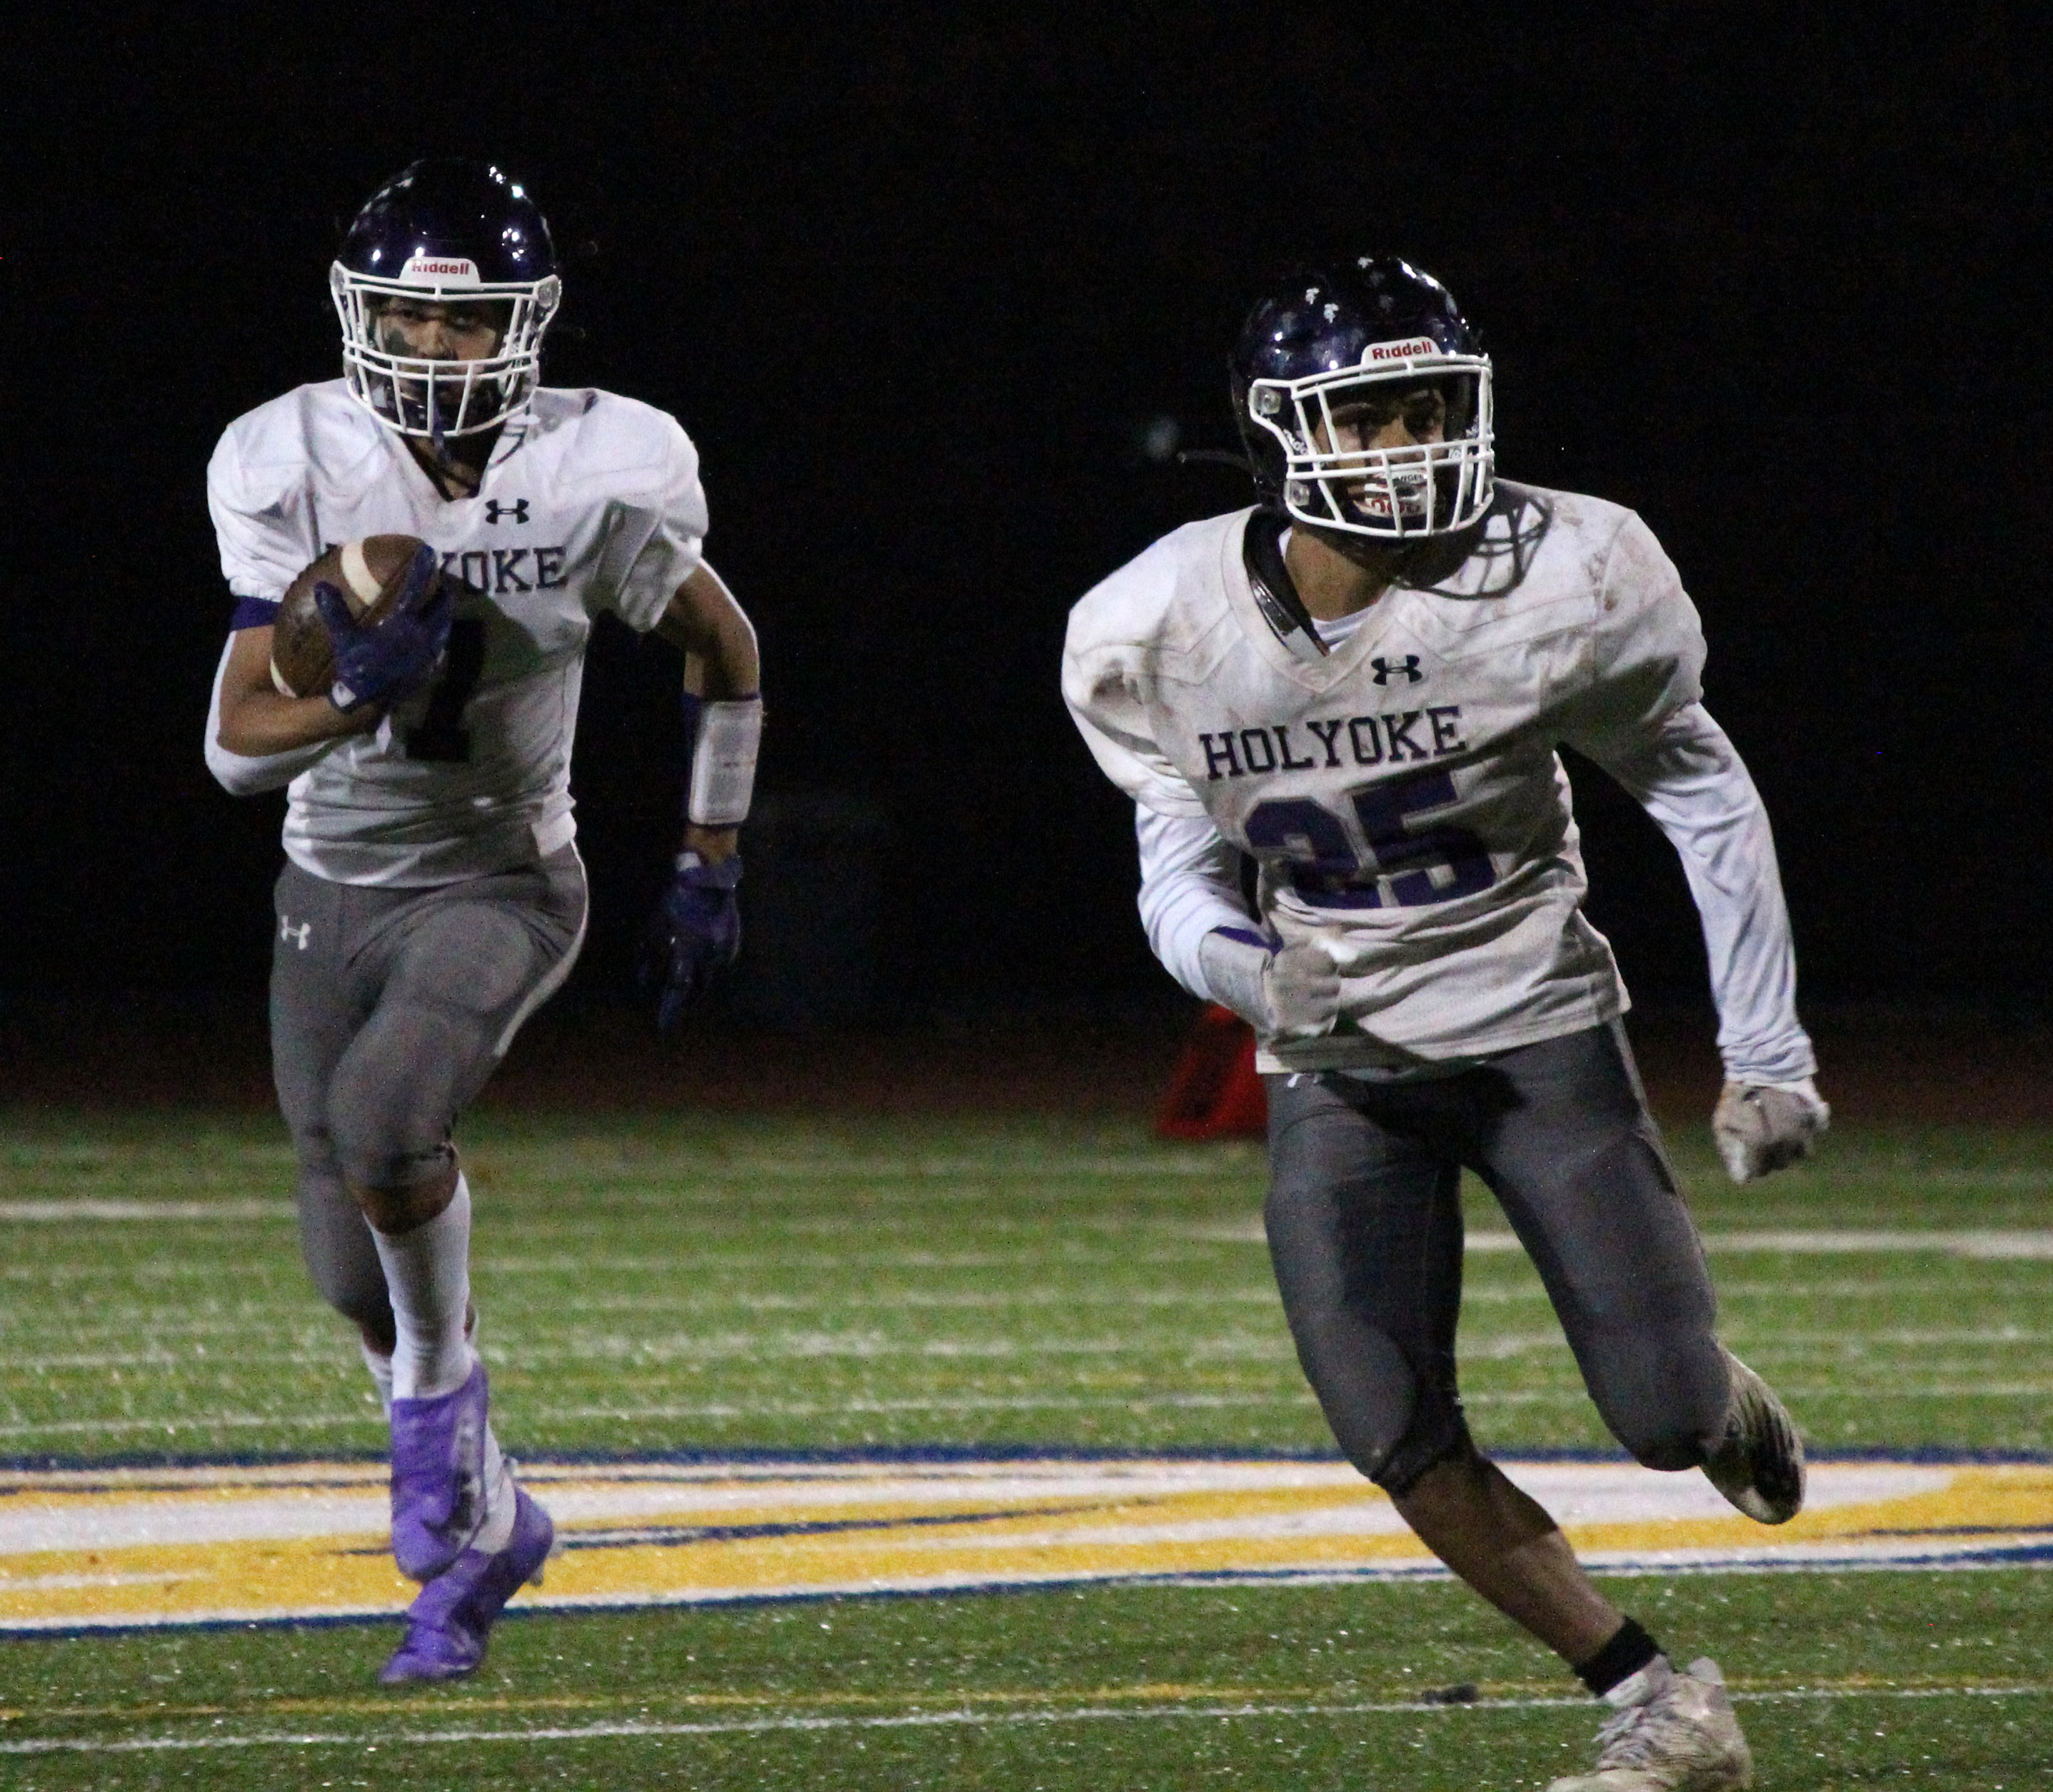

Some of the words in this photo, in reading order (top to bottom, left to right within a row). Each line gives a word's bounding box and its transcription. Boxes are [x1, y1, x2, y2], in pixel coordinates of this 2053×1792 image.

[412, 260, 469, 275] Riddell
[1372, 341, 1432, 360] Riddell
[1199, 705, 1467, 780] HOLYOKE
[1244, 770, 1497, 910] 25
